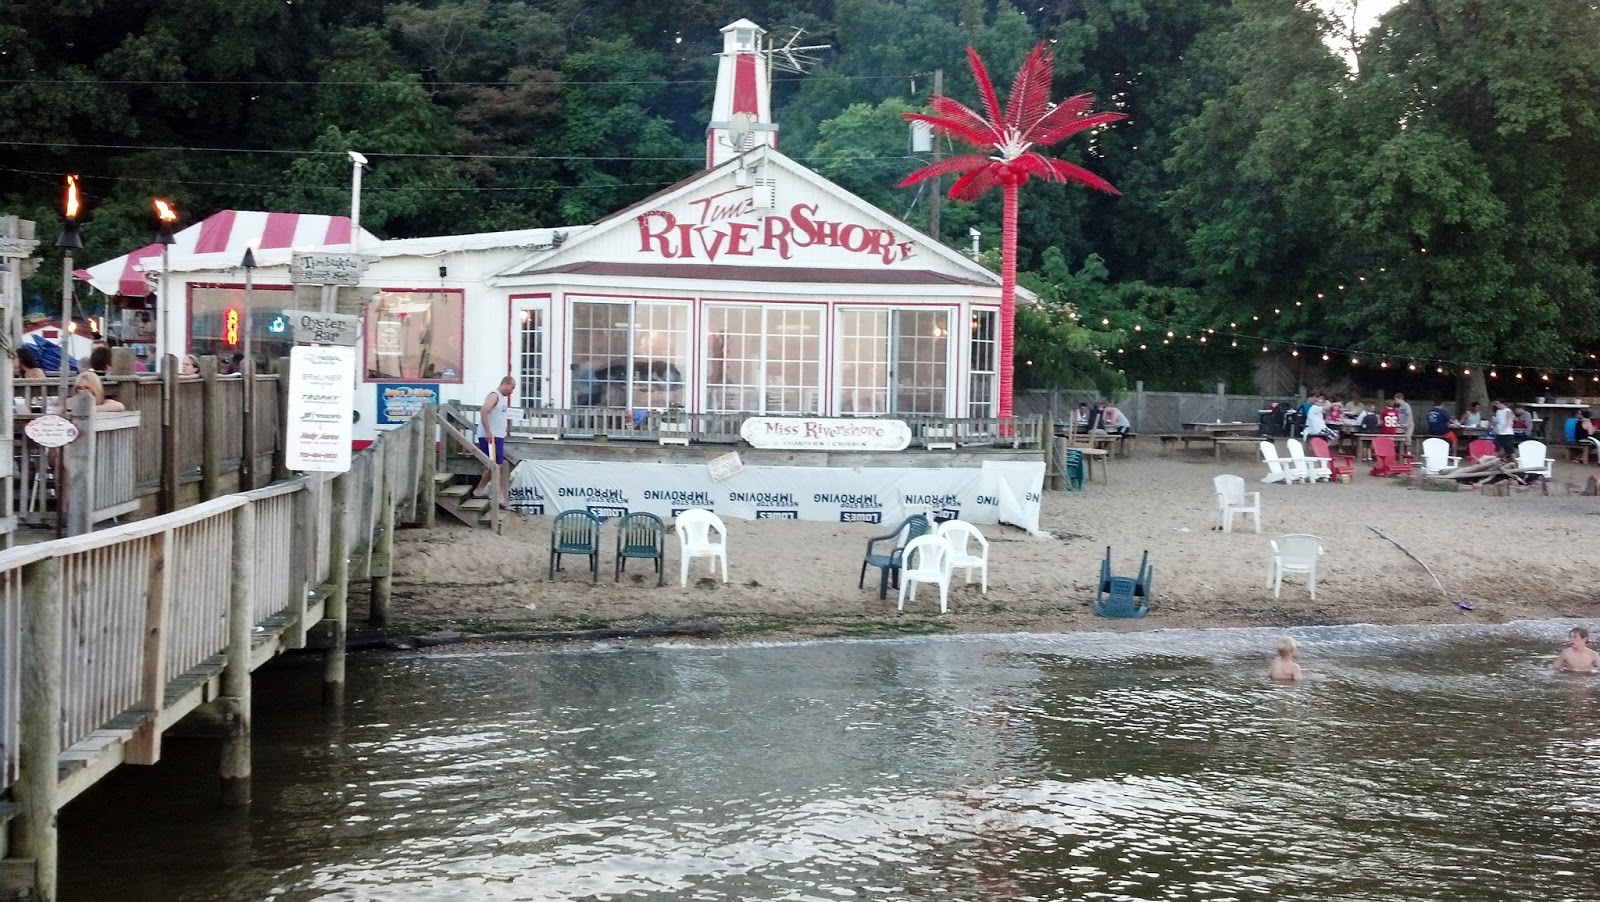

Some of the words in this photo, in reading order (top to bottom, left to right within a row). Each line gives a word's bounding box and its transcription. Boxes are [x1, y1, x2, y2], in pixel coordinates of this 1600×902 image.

[300, 315, 347, 330] Oyster
[312, 330, 340, 341] Bar
[764, 422, 799, 435] Miss
[803, 421, 885, 439] Rivershore
[558, 487, 623, 500] IMPROVING
[643, 491, 709, 501] IMPROVING
[729, 492, 794, 503] IMPROVING
[813, 494, 878, 504] IMPROVING
[905, 495, 958, 505] IMPROVIN
